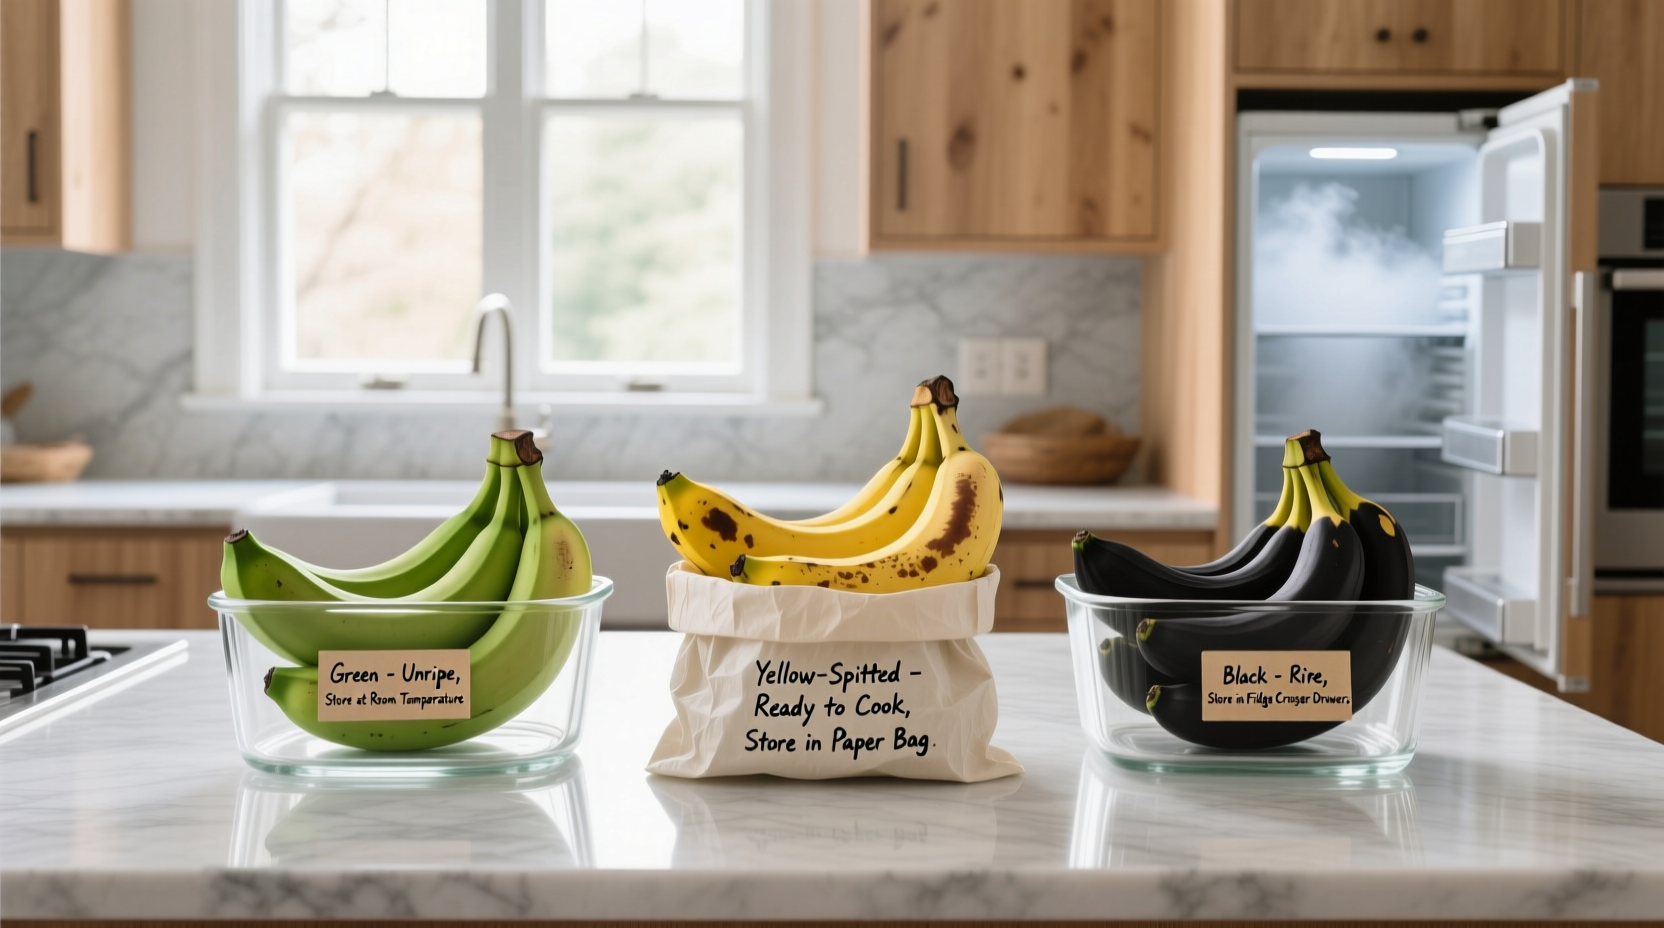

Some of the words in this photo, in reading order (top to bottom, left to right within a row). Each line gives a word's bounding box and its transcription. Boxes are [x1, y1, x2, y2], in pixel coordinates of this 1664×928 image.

[330, 661, 379, 684] Green
[402, 662, 461, 689] Unripe,
[755, 660, 902, 693] Yellow-Spitted
[1223, 665, 1268, 685] Black
[754, 692, 816, 727] Ready
[823, 696, 847, 717] to
[855, 691, 911, 719] Cook,
[744, 728, 797, 752] Store
[804, 733, 822, 751] in
[831, 726, 886, 761] Paper
[893, 726, 937, 757] Bag.
